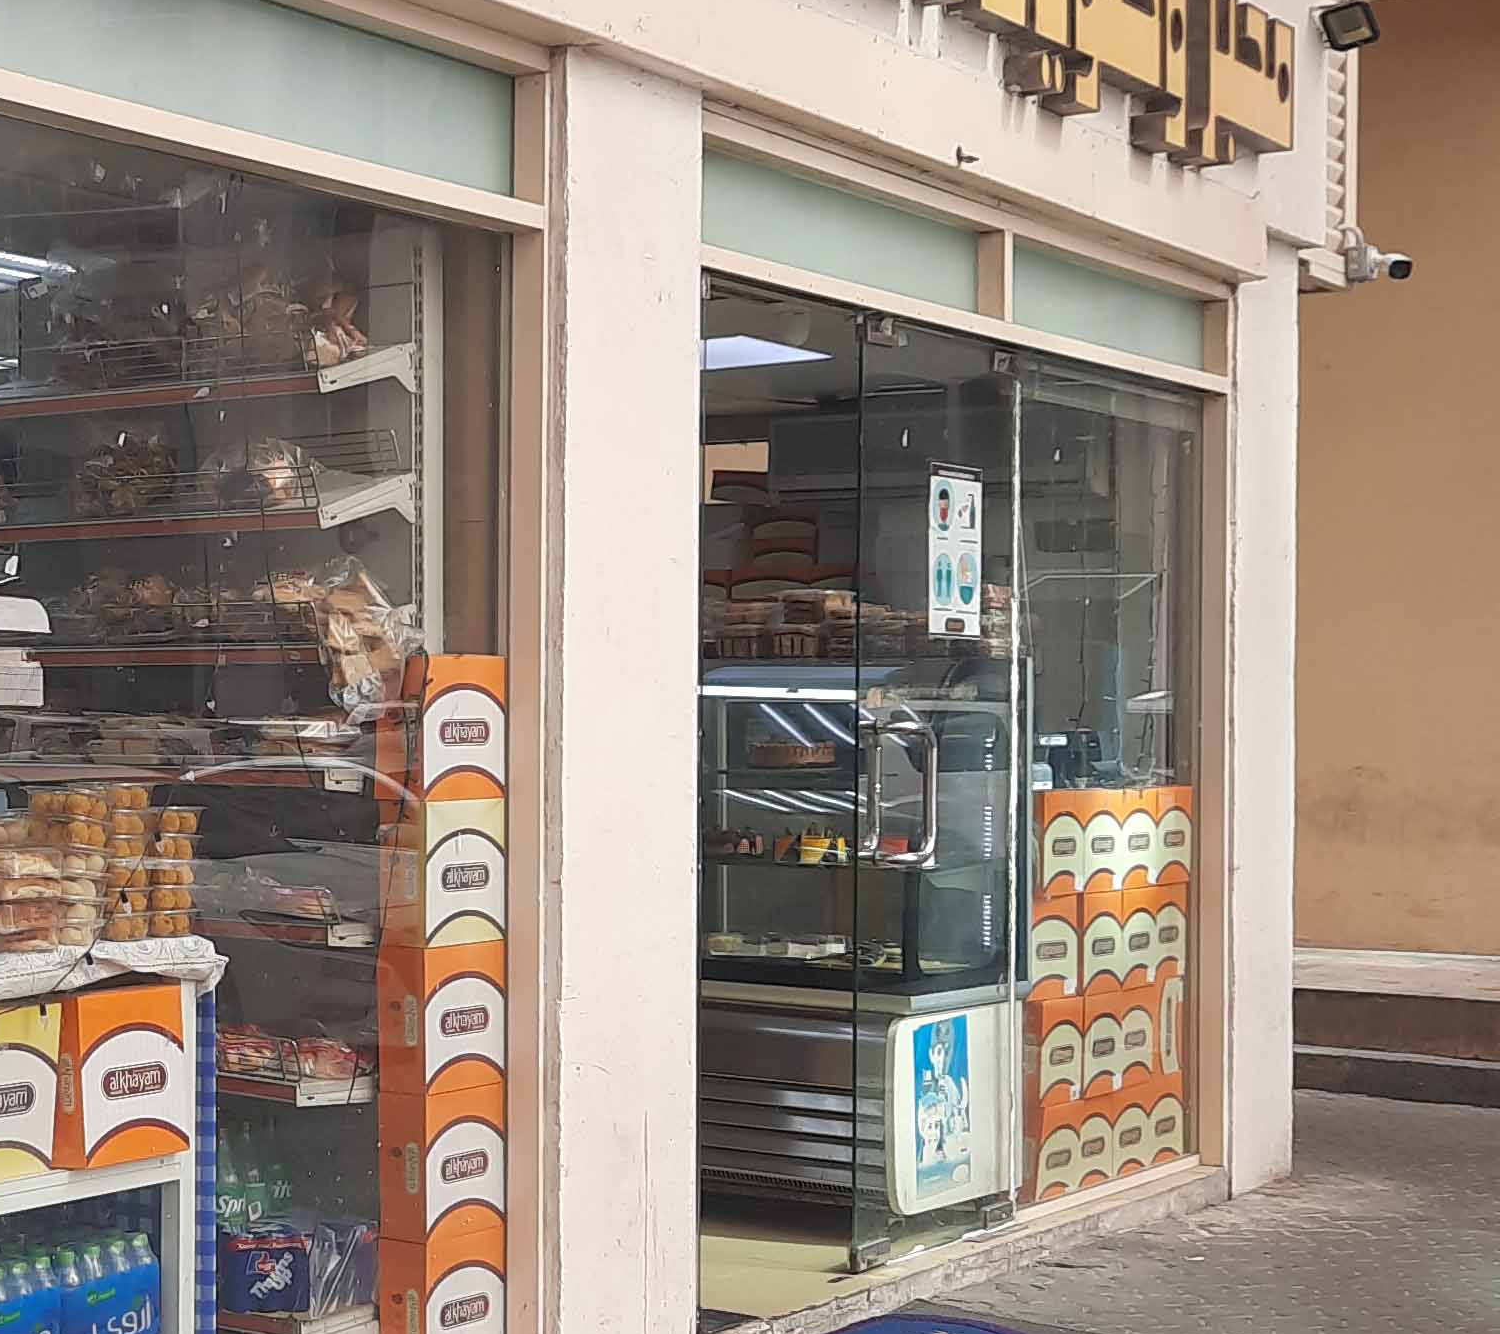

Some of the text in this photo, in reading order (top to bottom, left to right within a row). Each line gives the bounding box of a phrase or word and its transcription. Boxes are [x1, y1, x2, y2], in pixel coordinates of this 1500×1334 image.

[445, 722, 486, 743] alkhayam
[446, 867, 486, 888] alkhayam
[444, 1011, 486, 1032] alkhayam
[108, 1069, 162, 1094] alkhayam
[444, 1155, 485, 1178] alkhayam
[444, 1299, 485, 1324] alkhayam
